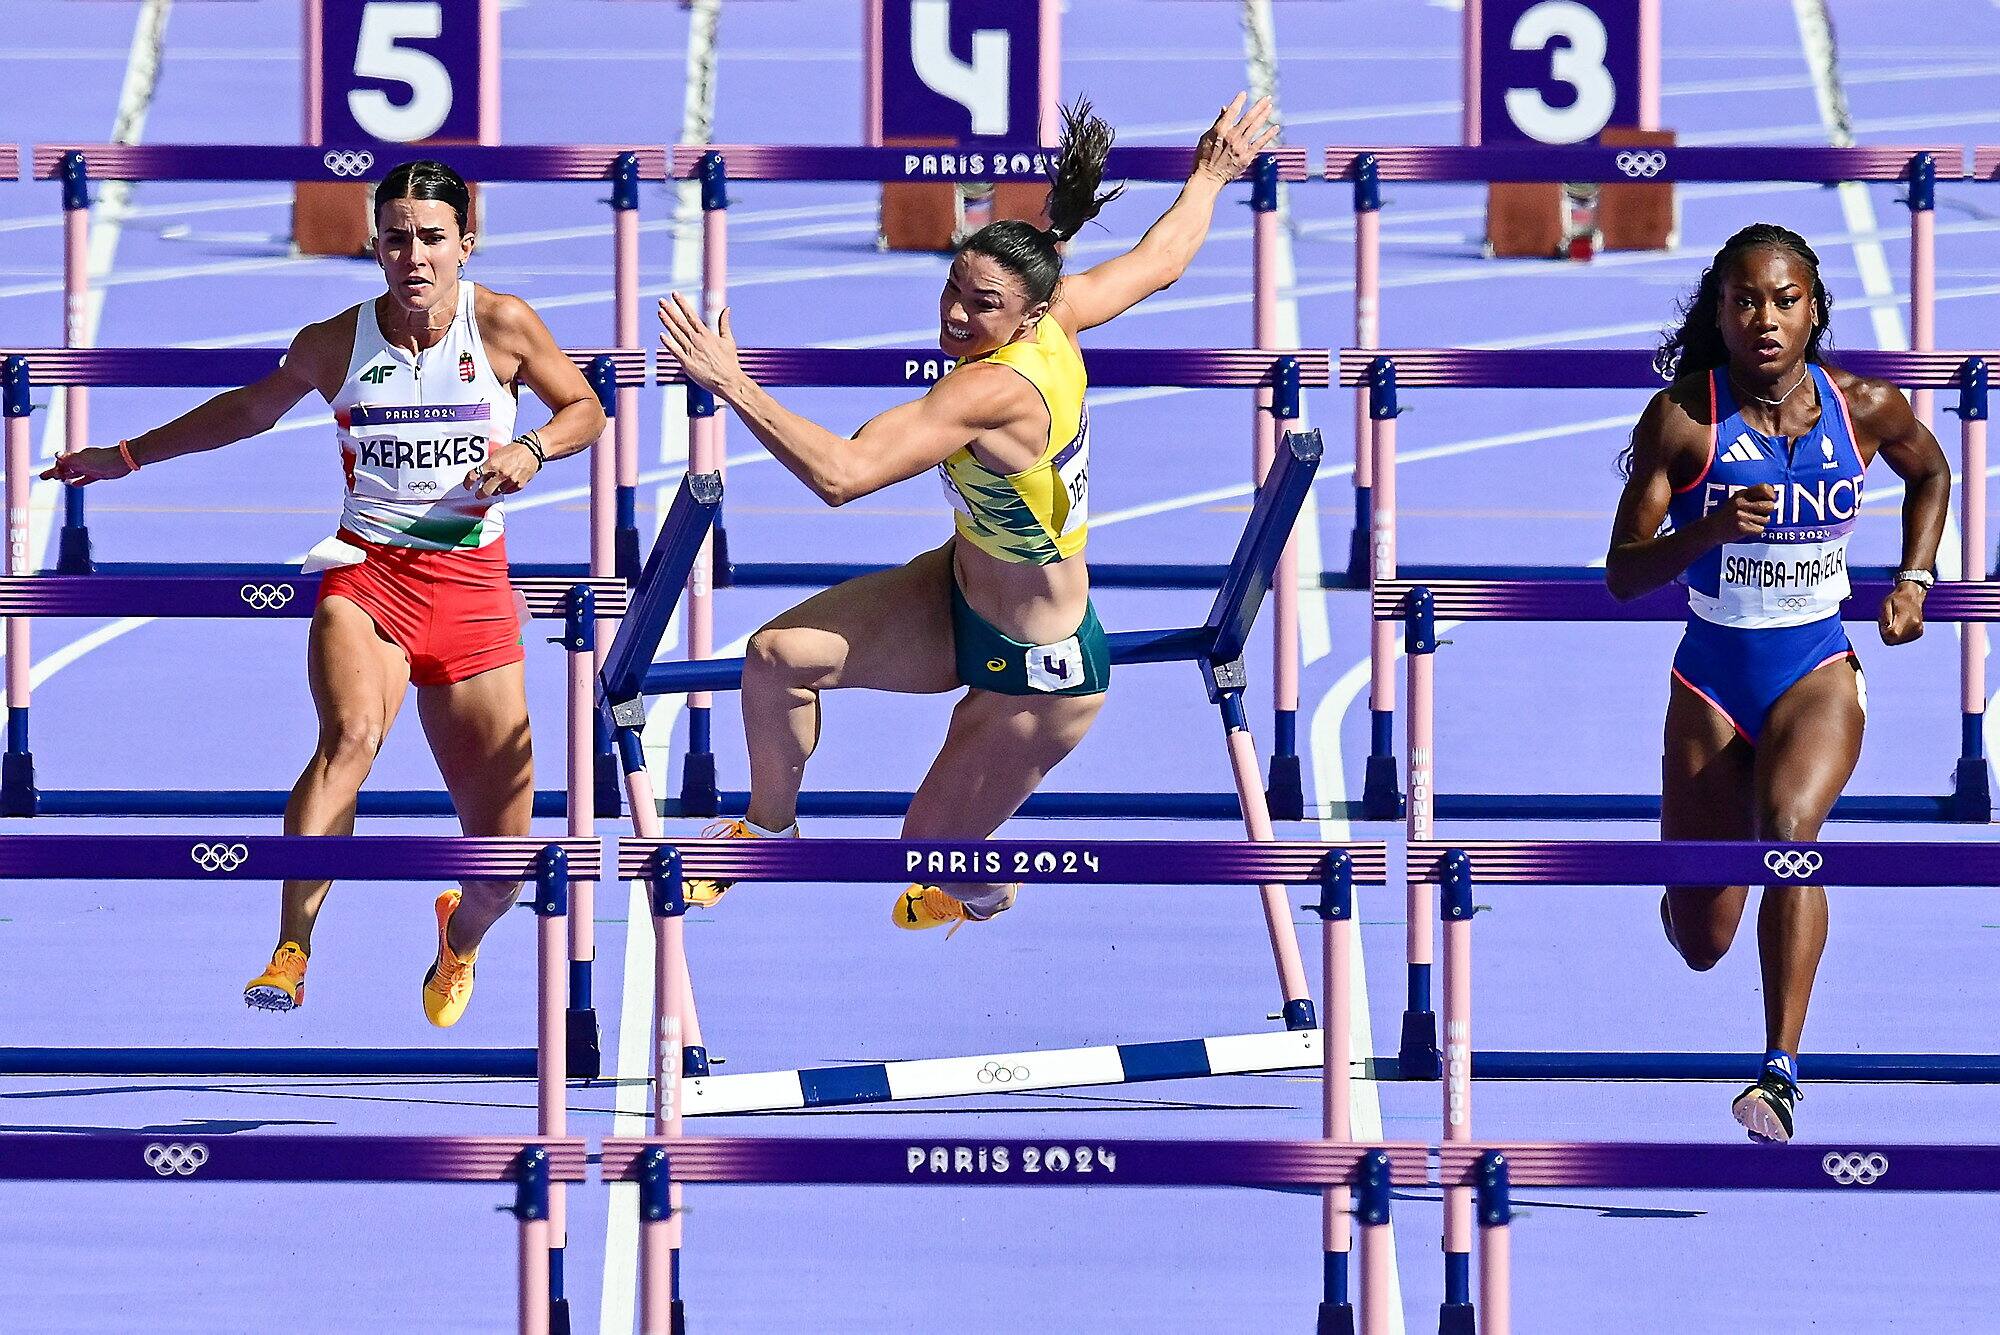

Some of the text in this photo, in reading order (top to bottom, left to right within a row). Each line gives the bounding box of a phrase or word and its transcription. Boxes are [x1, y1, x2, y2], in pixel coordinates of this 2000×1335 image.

[347, 1, 453, 143] 5
[910, 0, 1010, 136] 4
[1504, 0, 1616, 144] 3
[905, 359, 957, 380] PAR
[424, 408, 457, 418] 2024
[359, 435, 486, 470] KEREKES
[1702, 474, 1864, 525] FANCE
[1799, 530, 1831, 540] 2024
[1043, 654, 1068, 681] 4
[1013, 851, 1099, 873] 2024
[660, 1040, 679, 1121] MONDO
[1447, 1043, 1466, 1126] MONDO
[1022, 1146, 1116, 1173] 2024
